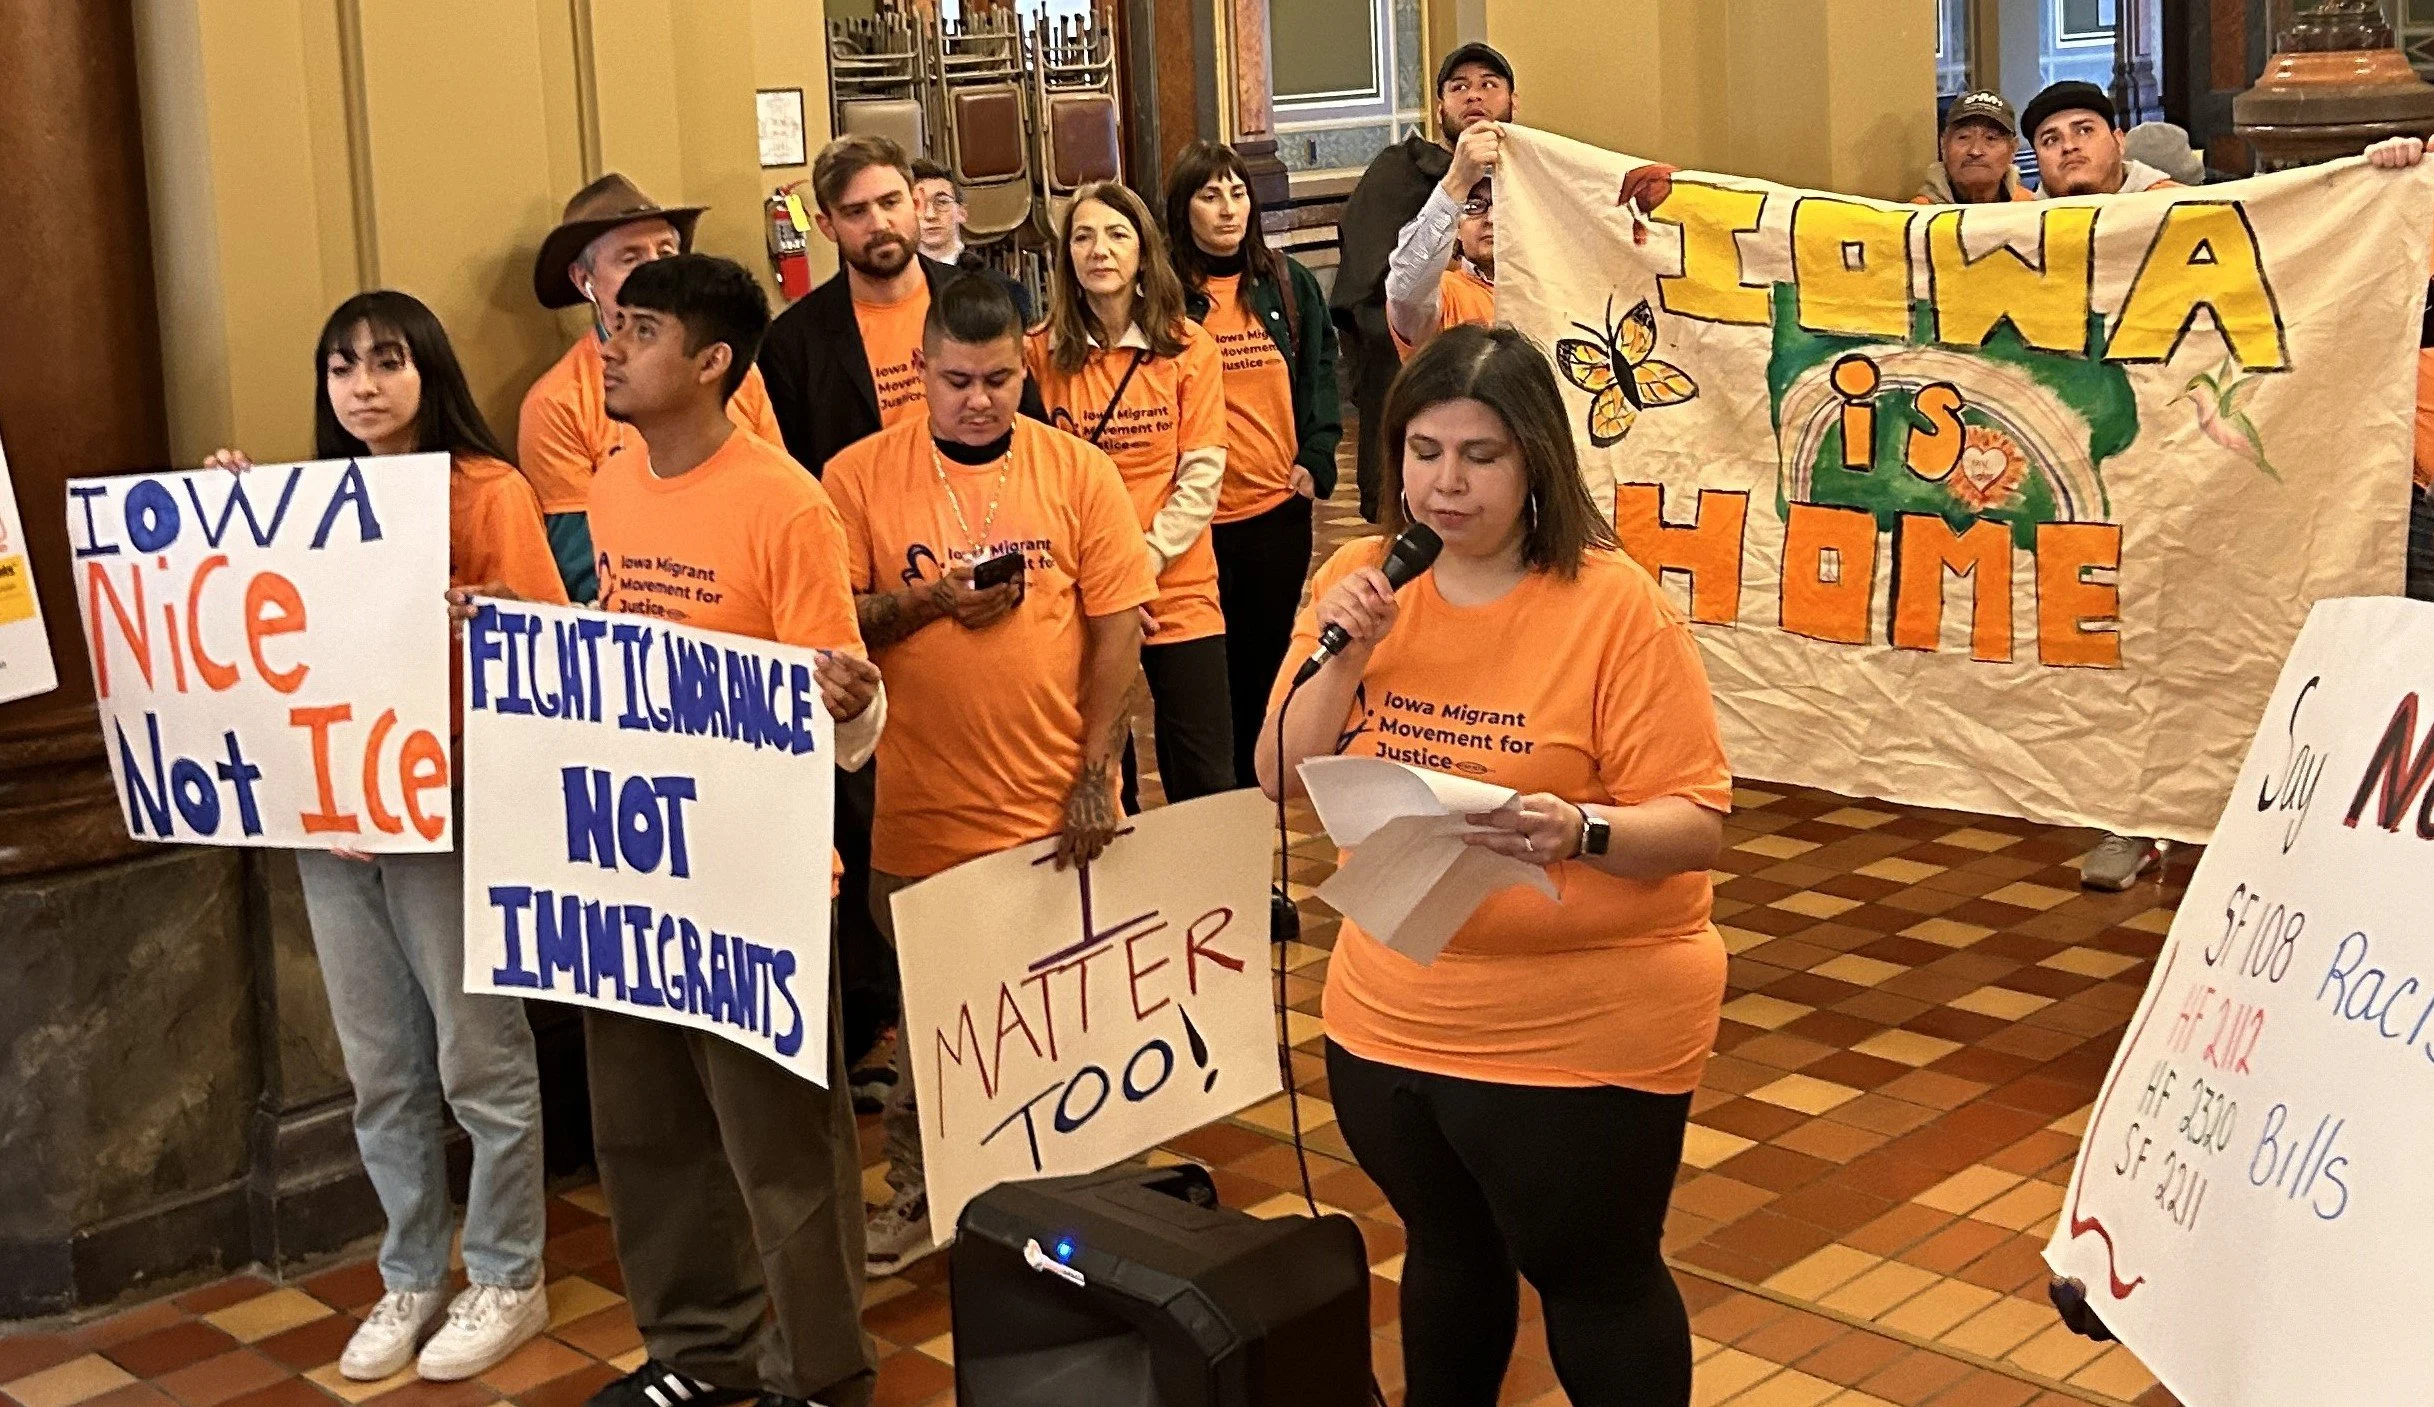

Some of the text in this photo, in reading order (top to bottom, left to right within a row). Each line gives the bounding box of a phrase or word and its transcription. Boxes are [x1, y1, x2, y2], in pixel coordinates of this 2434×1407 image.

[1650, 178, 2292, 373] IOWA
[875, 363, 908, 377] Iowa
[1215, 332, 1245, 344] Iowa
[1117, 406, 1169, 420] Migrant
[1829, 352, 1968, 482] is
[70, 457, 383, 557] IOWA
[991, 538, 1051, 557] Migrant
[619, 598, 665, 617] Justice
[620, 577, 723, 605] Movement for
[621, 555, 716, 583] Iowa Migrant
[1615, 481, 2124, 670] HOME
[469, 602, 816, 756] FIGHT IGNORANCE
[1383, 691, 1526, 728] Iowa Migrant
[114, 712, 263, 838] Not
[1375, 741, 1453, 769] Justice
[1379, 716, 1534, 755] Movement for
[2258, 675, 2330, 856] Say
[561, 767, 697, 879] NOT
[1029, 826, 1159, 972] I
[488, 885, 804, 1058] IMMIGRANTS
[936, 907, 1245, 1139] MATTER
[2167, 983, 2265, 1076] HF 2112
[981, 1003, 1219, 1172] TOO!
[2137, 1060, 2177, 1119] HF
[2114, 1122, 2208, 1232] SF 2211
[2249, 1103, 2348, 1220] Bills
